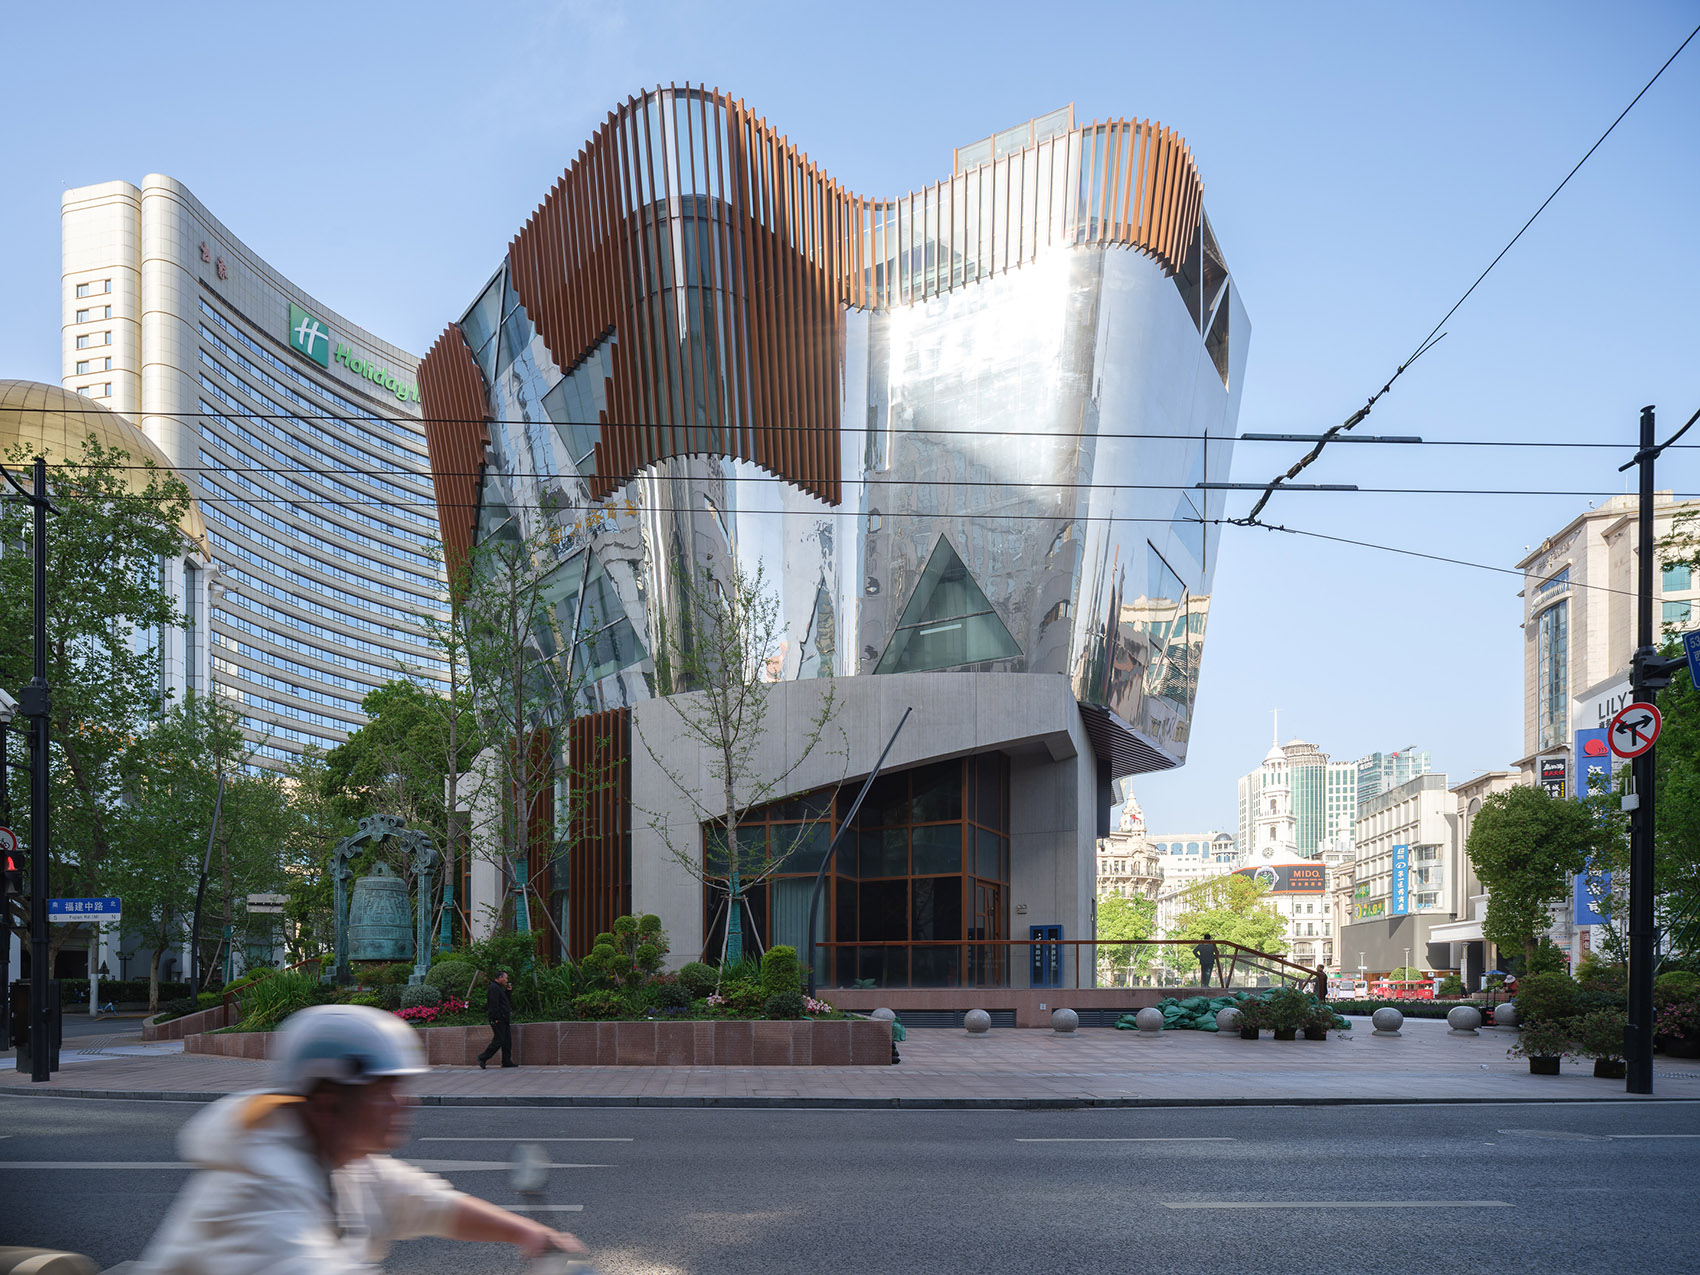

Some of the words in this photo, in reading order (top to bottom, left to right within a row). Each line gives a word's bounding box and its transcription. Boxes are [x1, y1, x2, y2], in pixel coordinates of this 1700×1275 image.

[334, 343, 410, 402] Holiday
[1598, 692, 1627, 720] LILY
[65, 901, 103, 911] 福建中路
